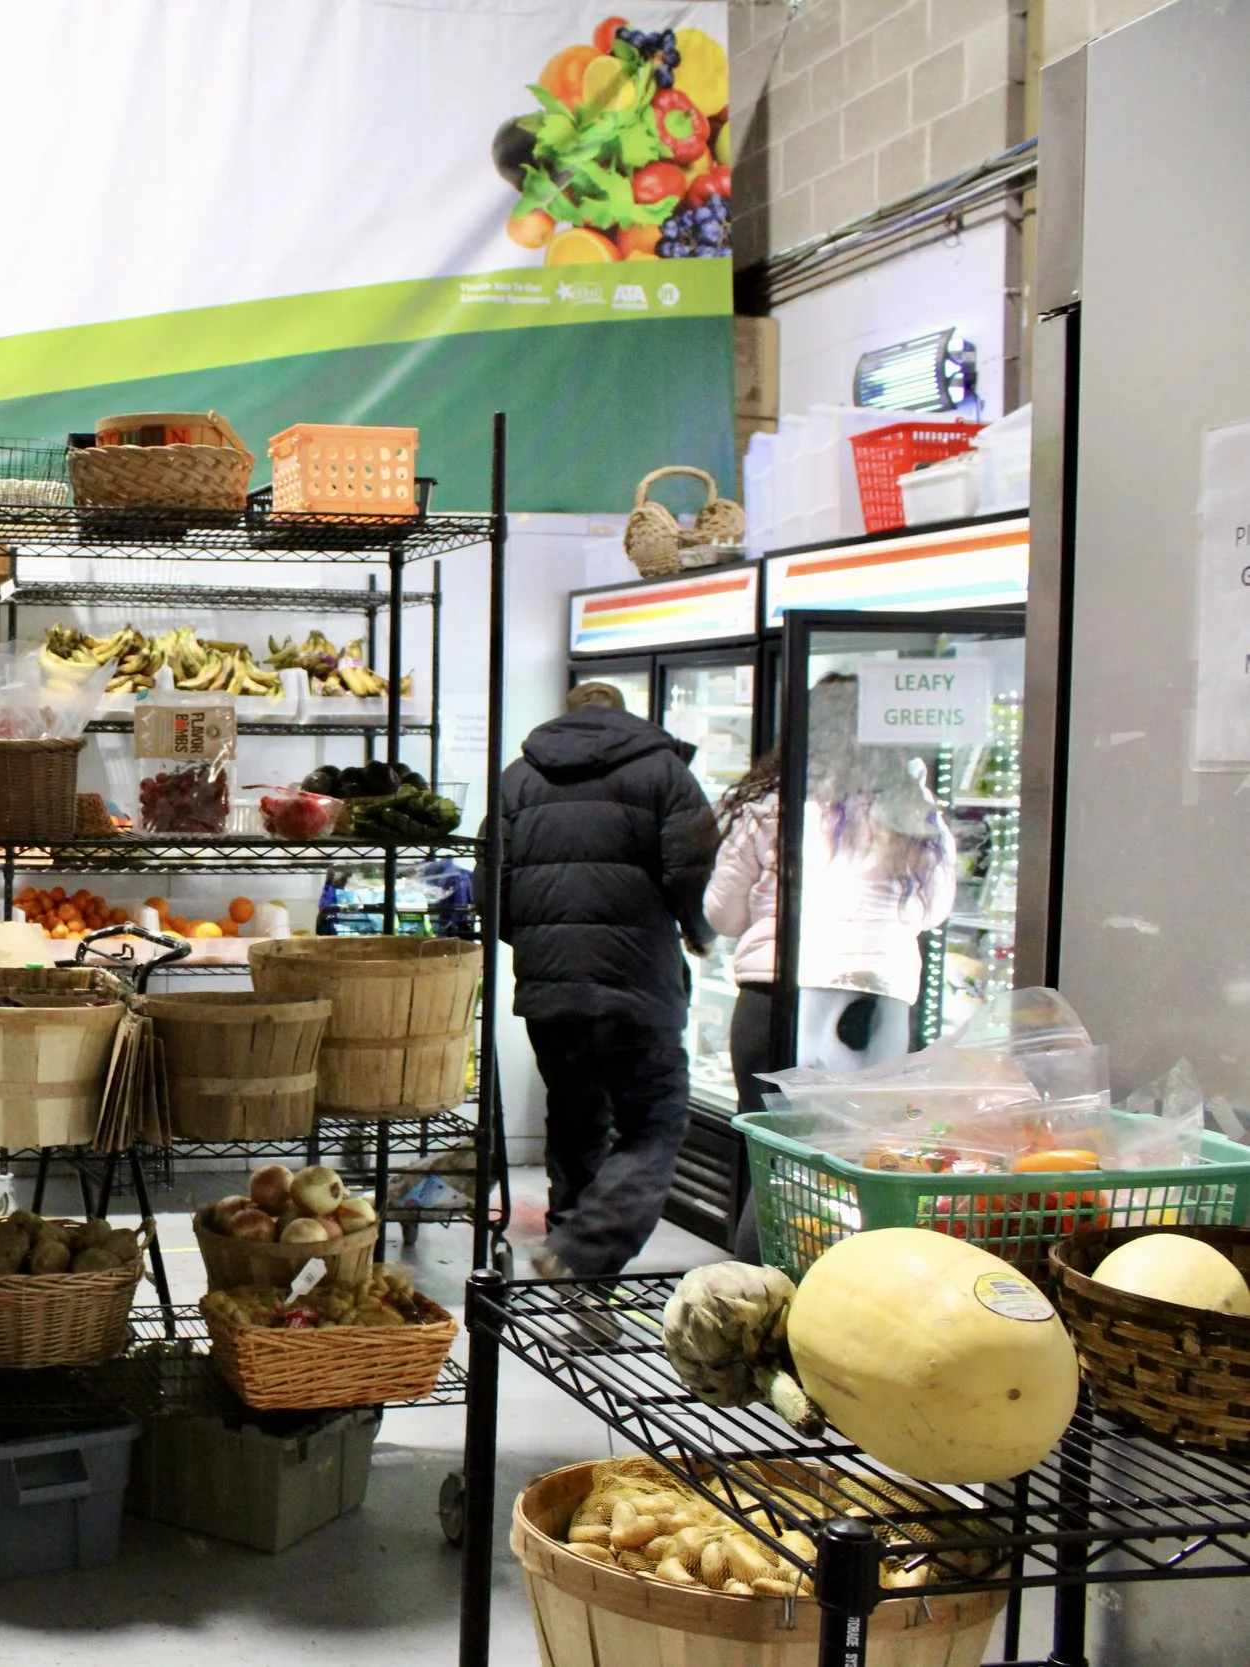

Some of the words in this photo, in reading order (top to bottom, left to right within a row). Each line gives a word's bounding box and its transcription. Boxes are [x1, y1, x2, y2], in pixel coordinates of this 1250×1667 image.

[895, 674, 955, 691] LEAFY
[884, 708, 965, 726] GREENS
[190, 712, 205, 753] FLAVOR
[846, 1616, 860, 1648] TORAGE
